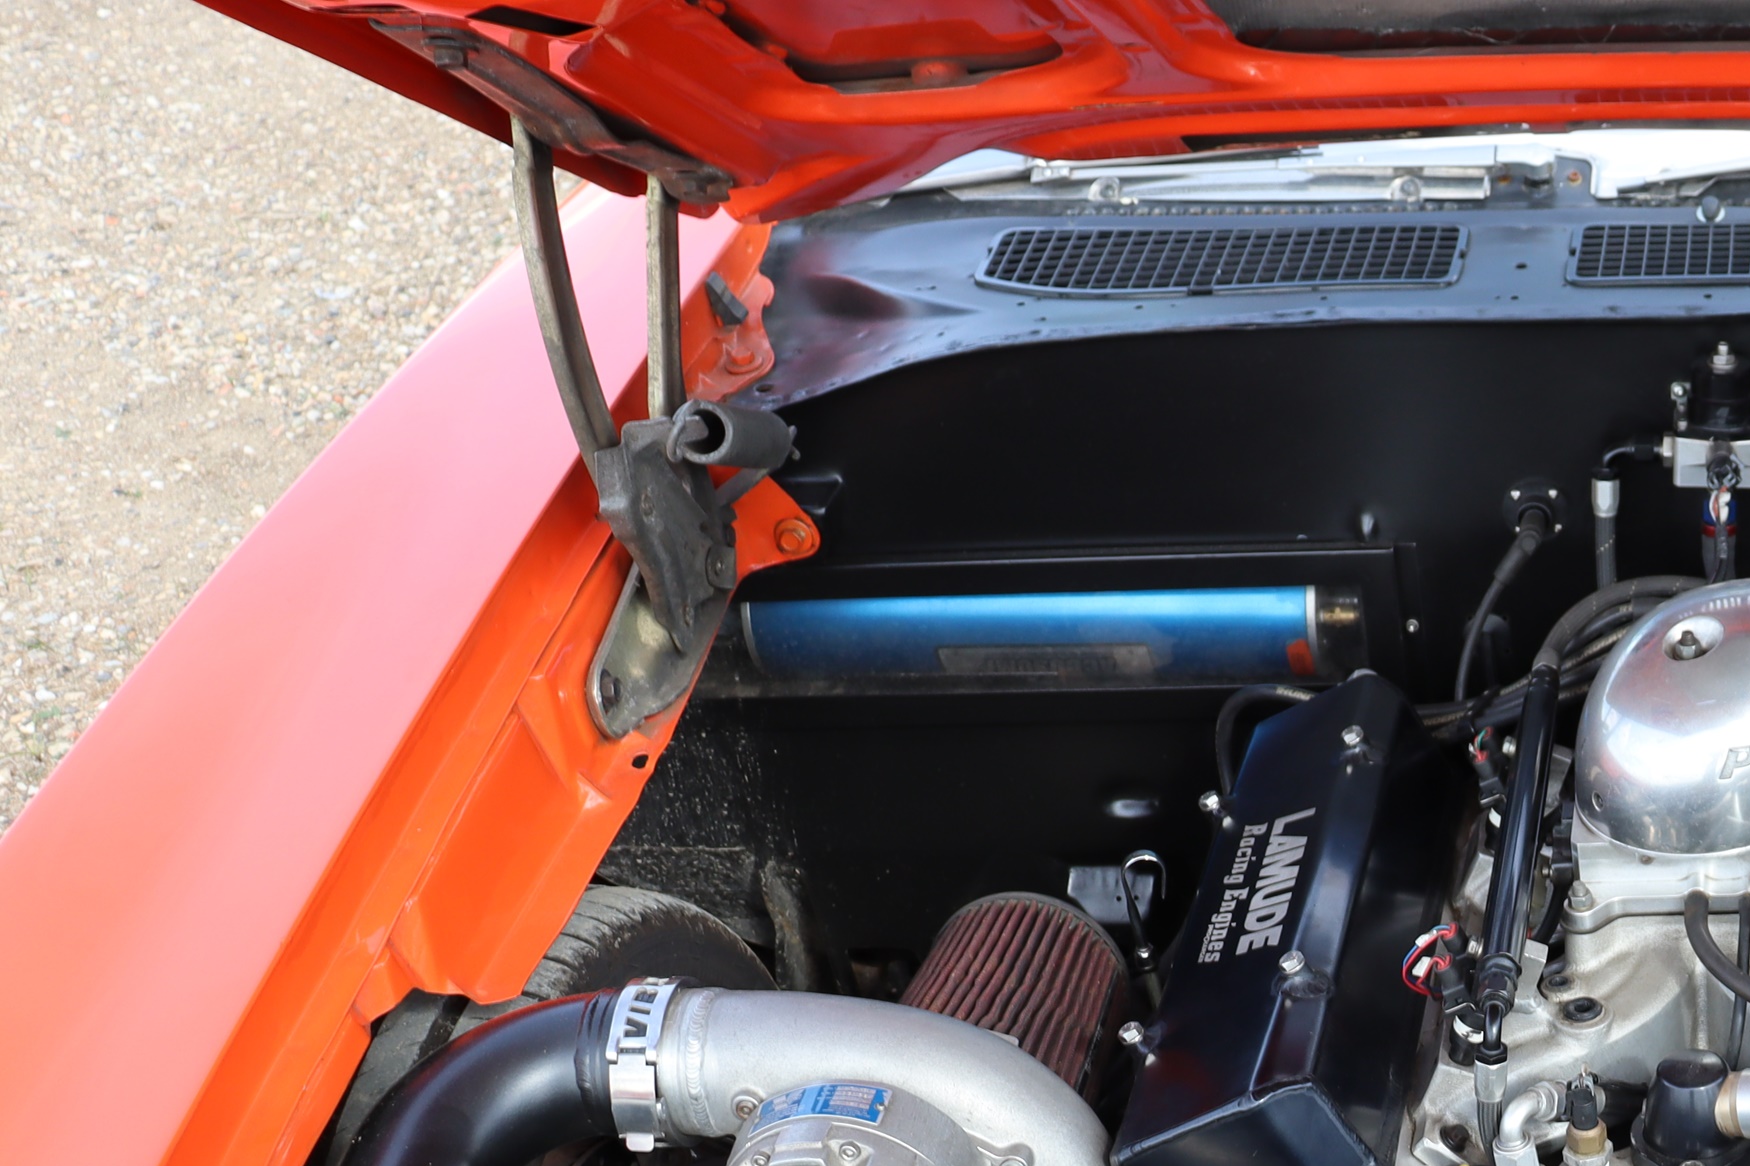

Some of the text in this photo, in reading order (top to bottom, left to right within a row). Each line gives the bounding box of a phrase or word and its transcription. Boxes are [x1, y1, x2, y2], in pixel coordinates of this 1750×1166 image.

[1204, 822, 1268, 963] Racing Engines
[1236, 807, 1316, 956] LAMUDE
